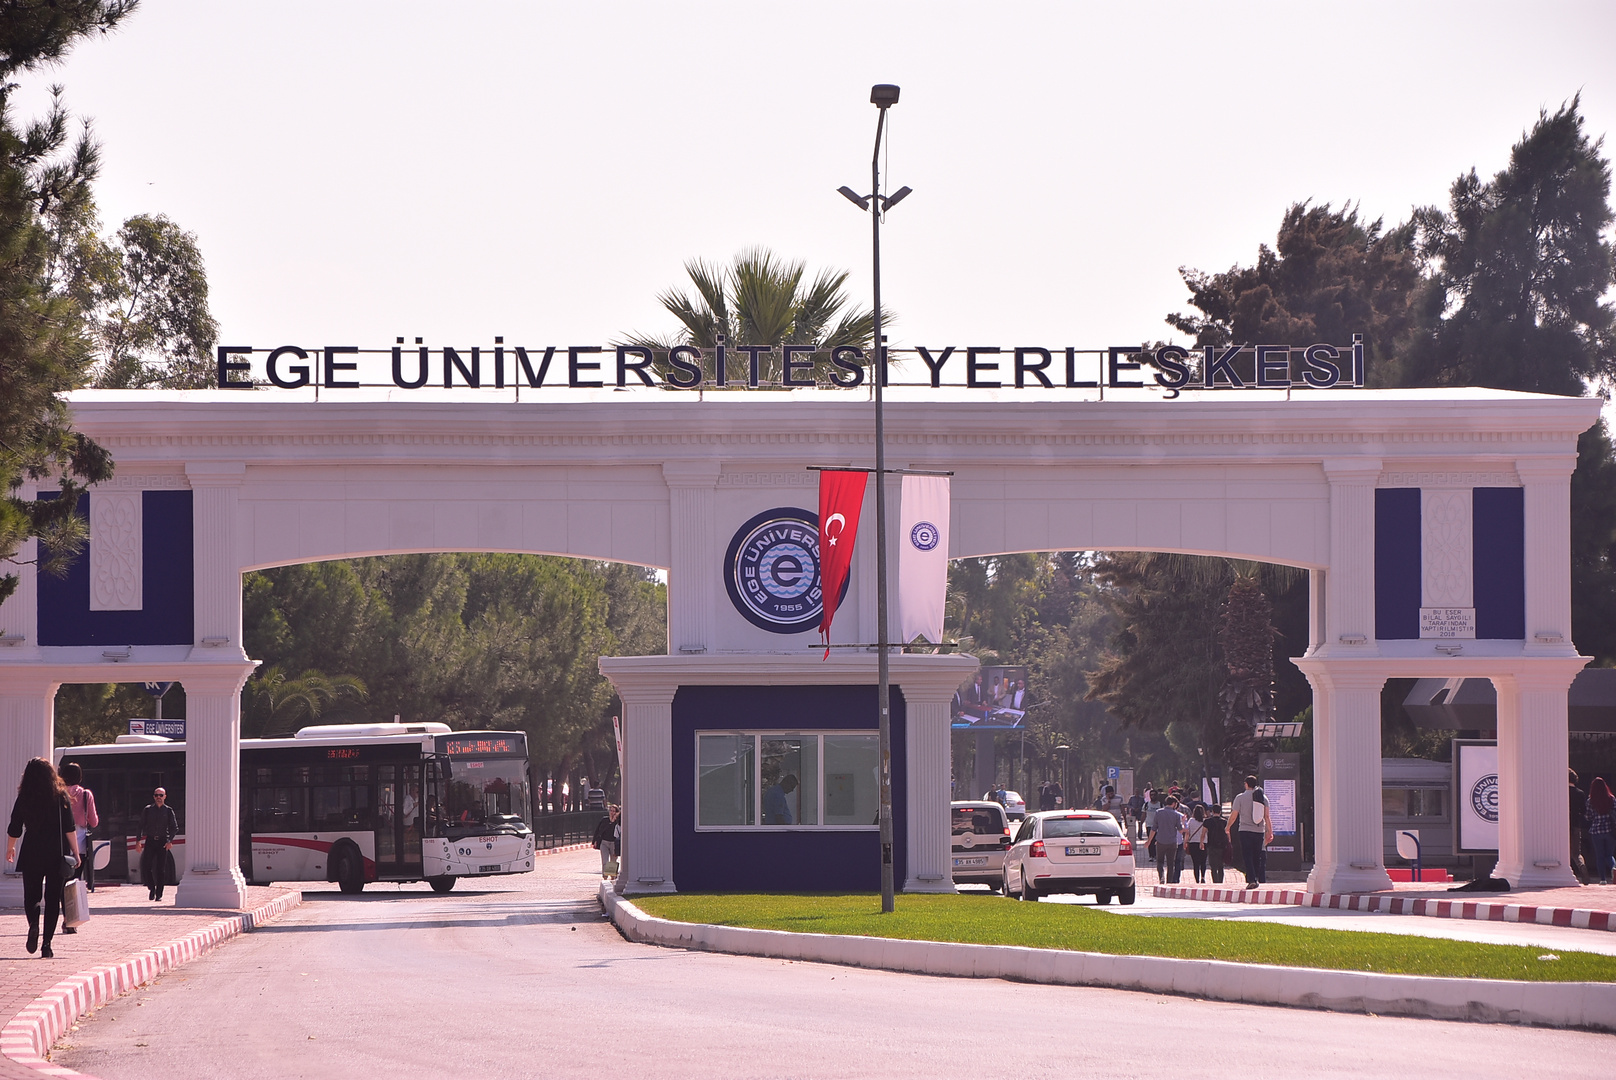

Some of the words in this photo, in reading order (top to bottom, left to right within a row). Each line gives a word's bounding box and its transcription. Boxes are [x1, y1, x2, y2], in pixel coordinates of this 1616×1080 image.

[217, 345, 360, 389] EGE
[391, 334, 888, 389] ÜNİVERSİTESİ
[914, 333, 1364, 399] YERLEŞKESİ
[744, 566, 769, 605] EGE
[773, 603, 803, 612] 1955
[145, 723, 156, 734] EGE
